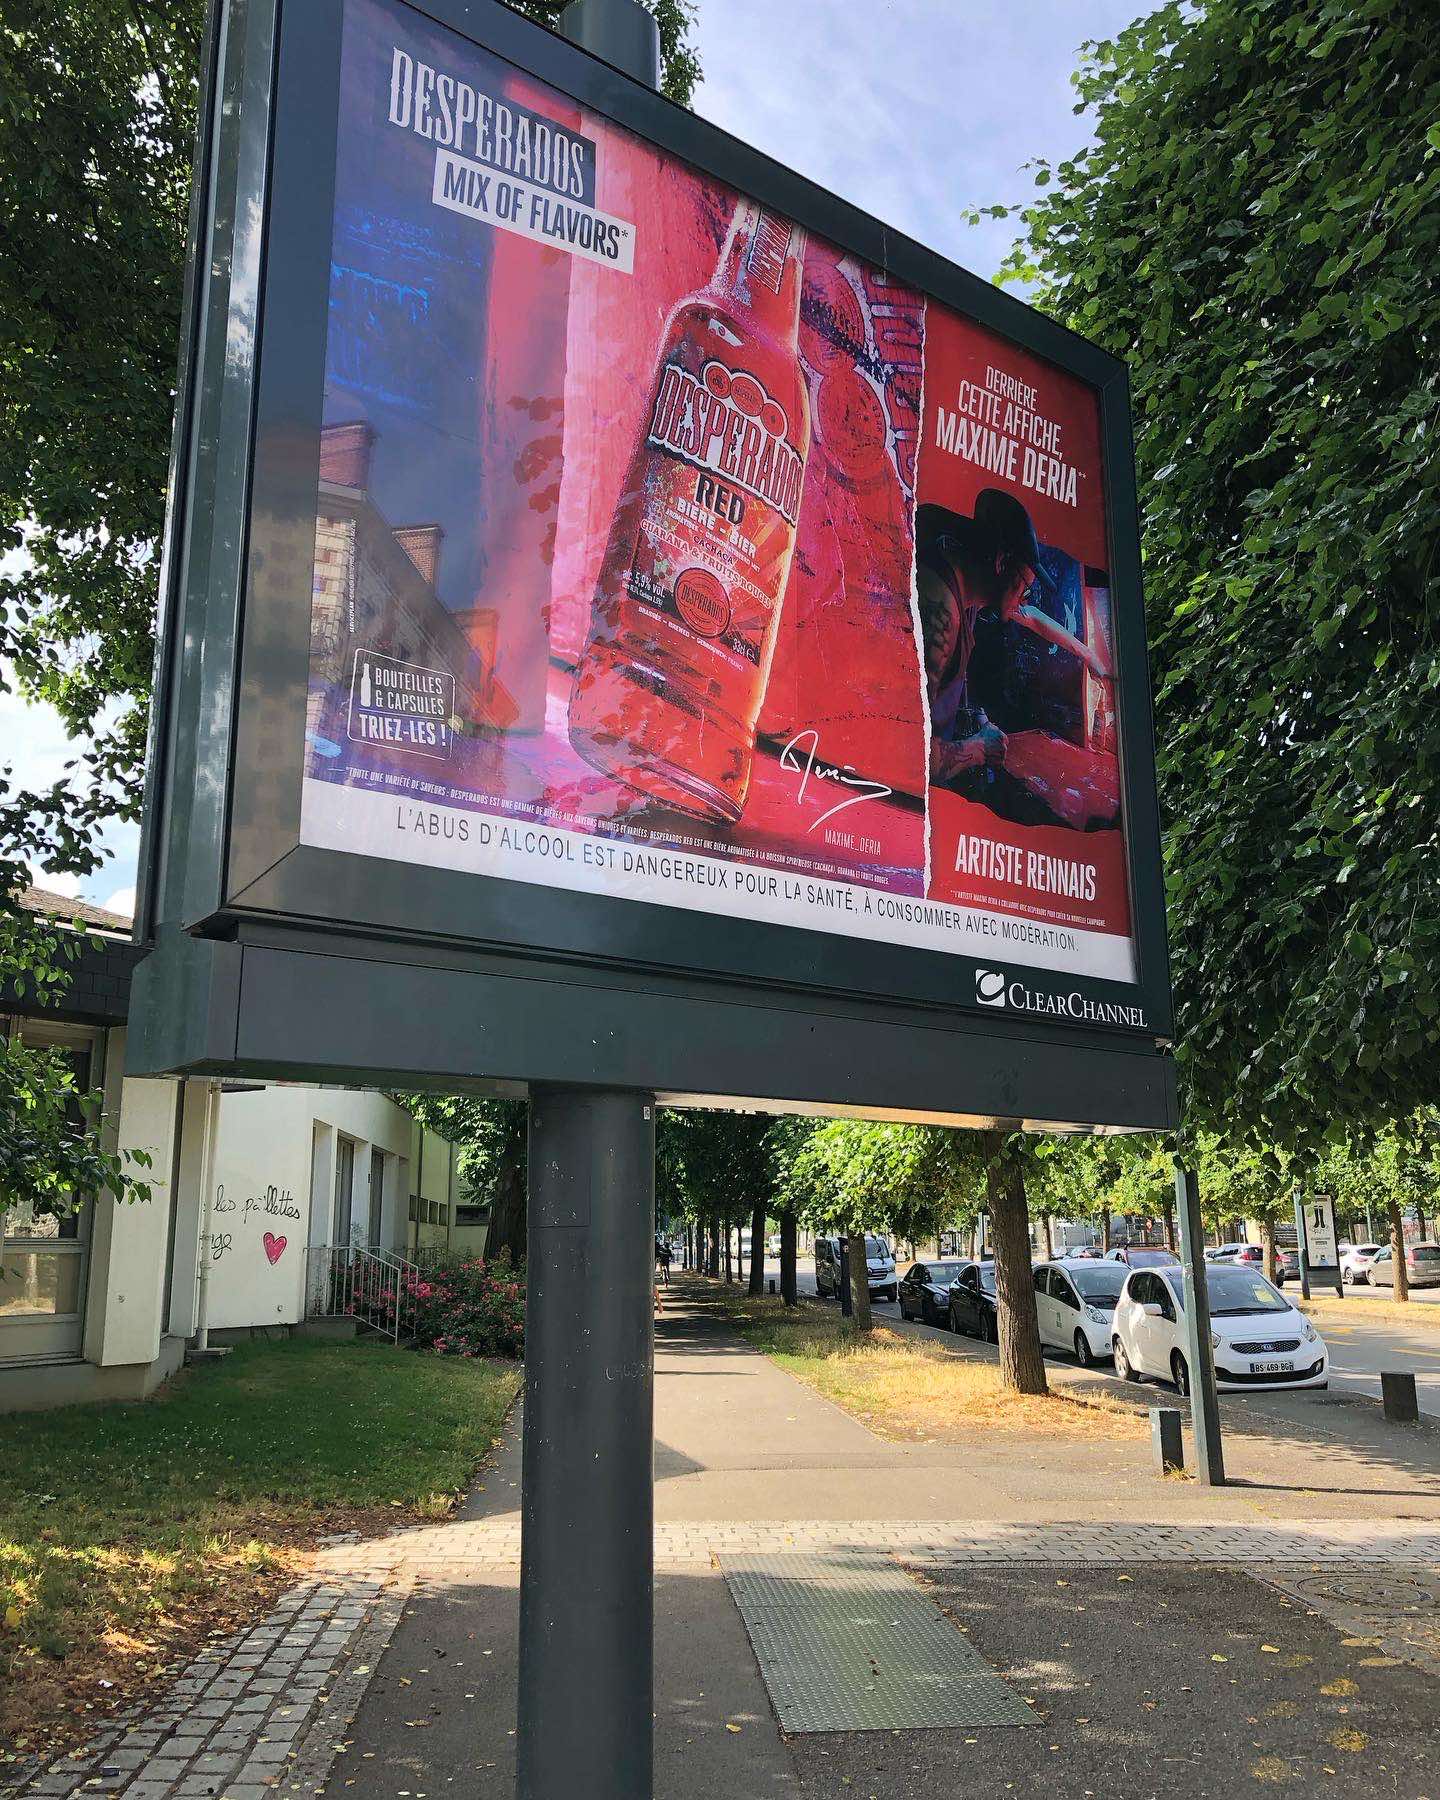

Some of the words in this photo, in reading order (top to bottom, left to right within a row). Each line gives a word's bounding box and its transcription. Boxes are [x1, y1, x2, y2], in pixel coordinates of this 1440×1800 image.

[388, 47, 584, 198] DESPERADOS
[443, 161, 488, 213] MIX
[495, 175, 525, 222] OF
[985, 365, 1038, 412] DERRIÈRE
[935, 406, 1019, 482] MAXIME
[958, 379, 1002, 429] CETTE
[1003, 402, 1062, 461] AFFICHE,
[696, 473, 745, 525] RED
[702, 552, 741, 584] FRUITS
[740, 576, 773, 610] ROUGES
[375, 667, 443, 695] BOUTEILLES
[375, 690, 384, 708] &
[387, 691, 445, 716] CAPSULES
[359, 713, 436, 746] TRIEZ-LES
[440, 723, 446, 747] !
[397, 806, 470, 842] L'ABUS
[480, 822, 575, 861] D'ALCOOL
[583, 842, 616, 869] EST
[624, 851, 728, 889] DANGEREUX
[735, 871, 778, 898] POUR
[784, 880, 802, 901] LA
[807, 884, 858, 914] SANTÉ,
[864, 891, 873, 914] À
[877, 898, 960, 930] CONSOMMER
[965, 914, 998, 937] AVEC
[1002, 923, 1080, 952] MODÉRATION.
[955, 833, 1022, 886] ARTISTE
[1027, 849, 1097, 902] RENNAIS
